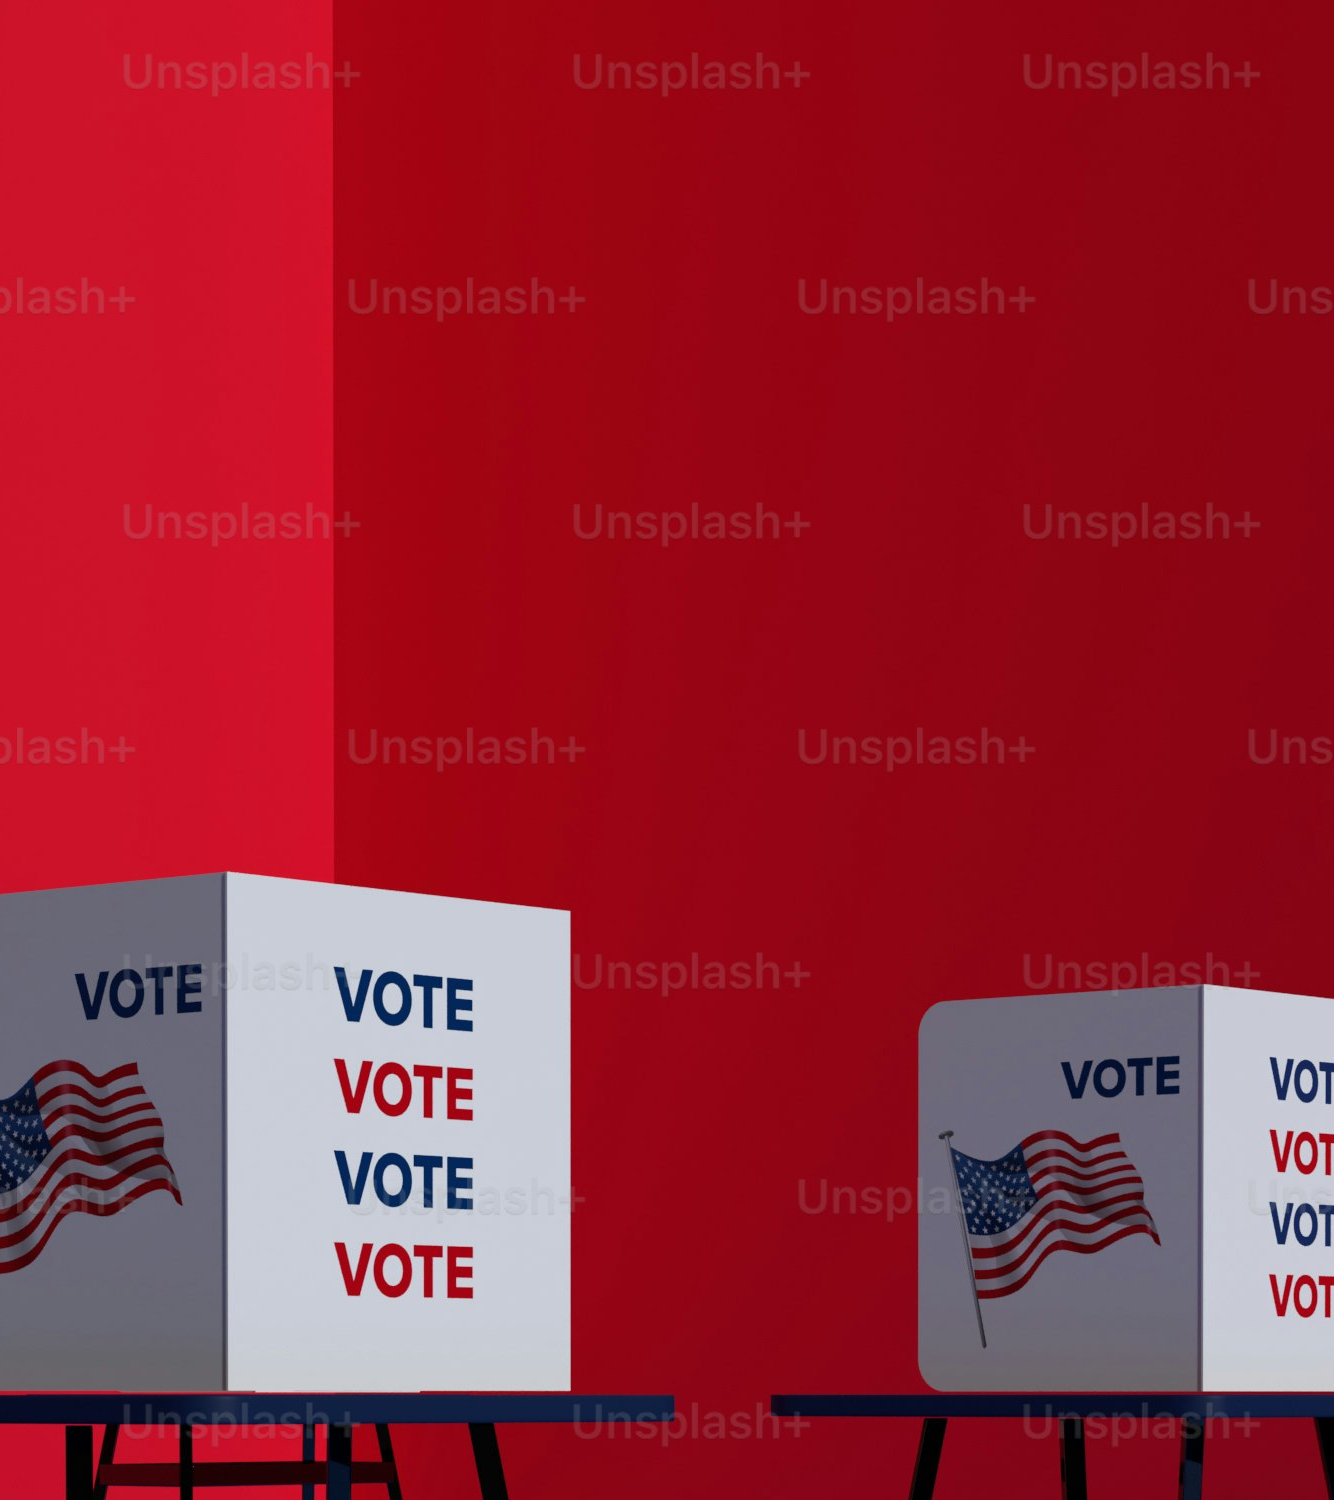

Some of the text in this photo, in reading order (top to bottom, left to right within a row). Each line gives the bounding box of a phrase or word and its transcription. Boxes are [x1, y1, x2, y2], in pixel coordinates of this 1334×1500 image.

[75, 964, 202, 1020] VOTE
[334, 967, 473, 1032] VOTE
[334, 1059, 473, 1121] VOTE
[1061, 1056, 1179, 1099] VOTE
[334, 1150, 473, 1209] VOTE
[334, 1242, 473, 1298] VOTE
